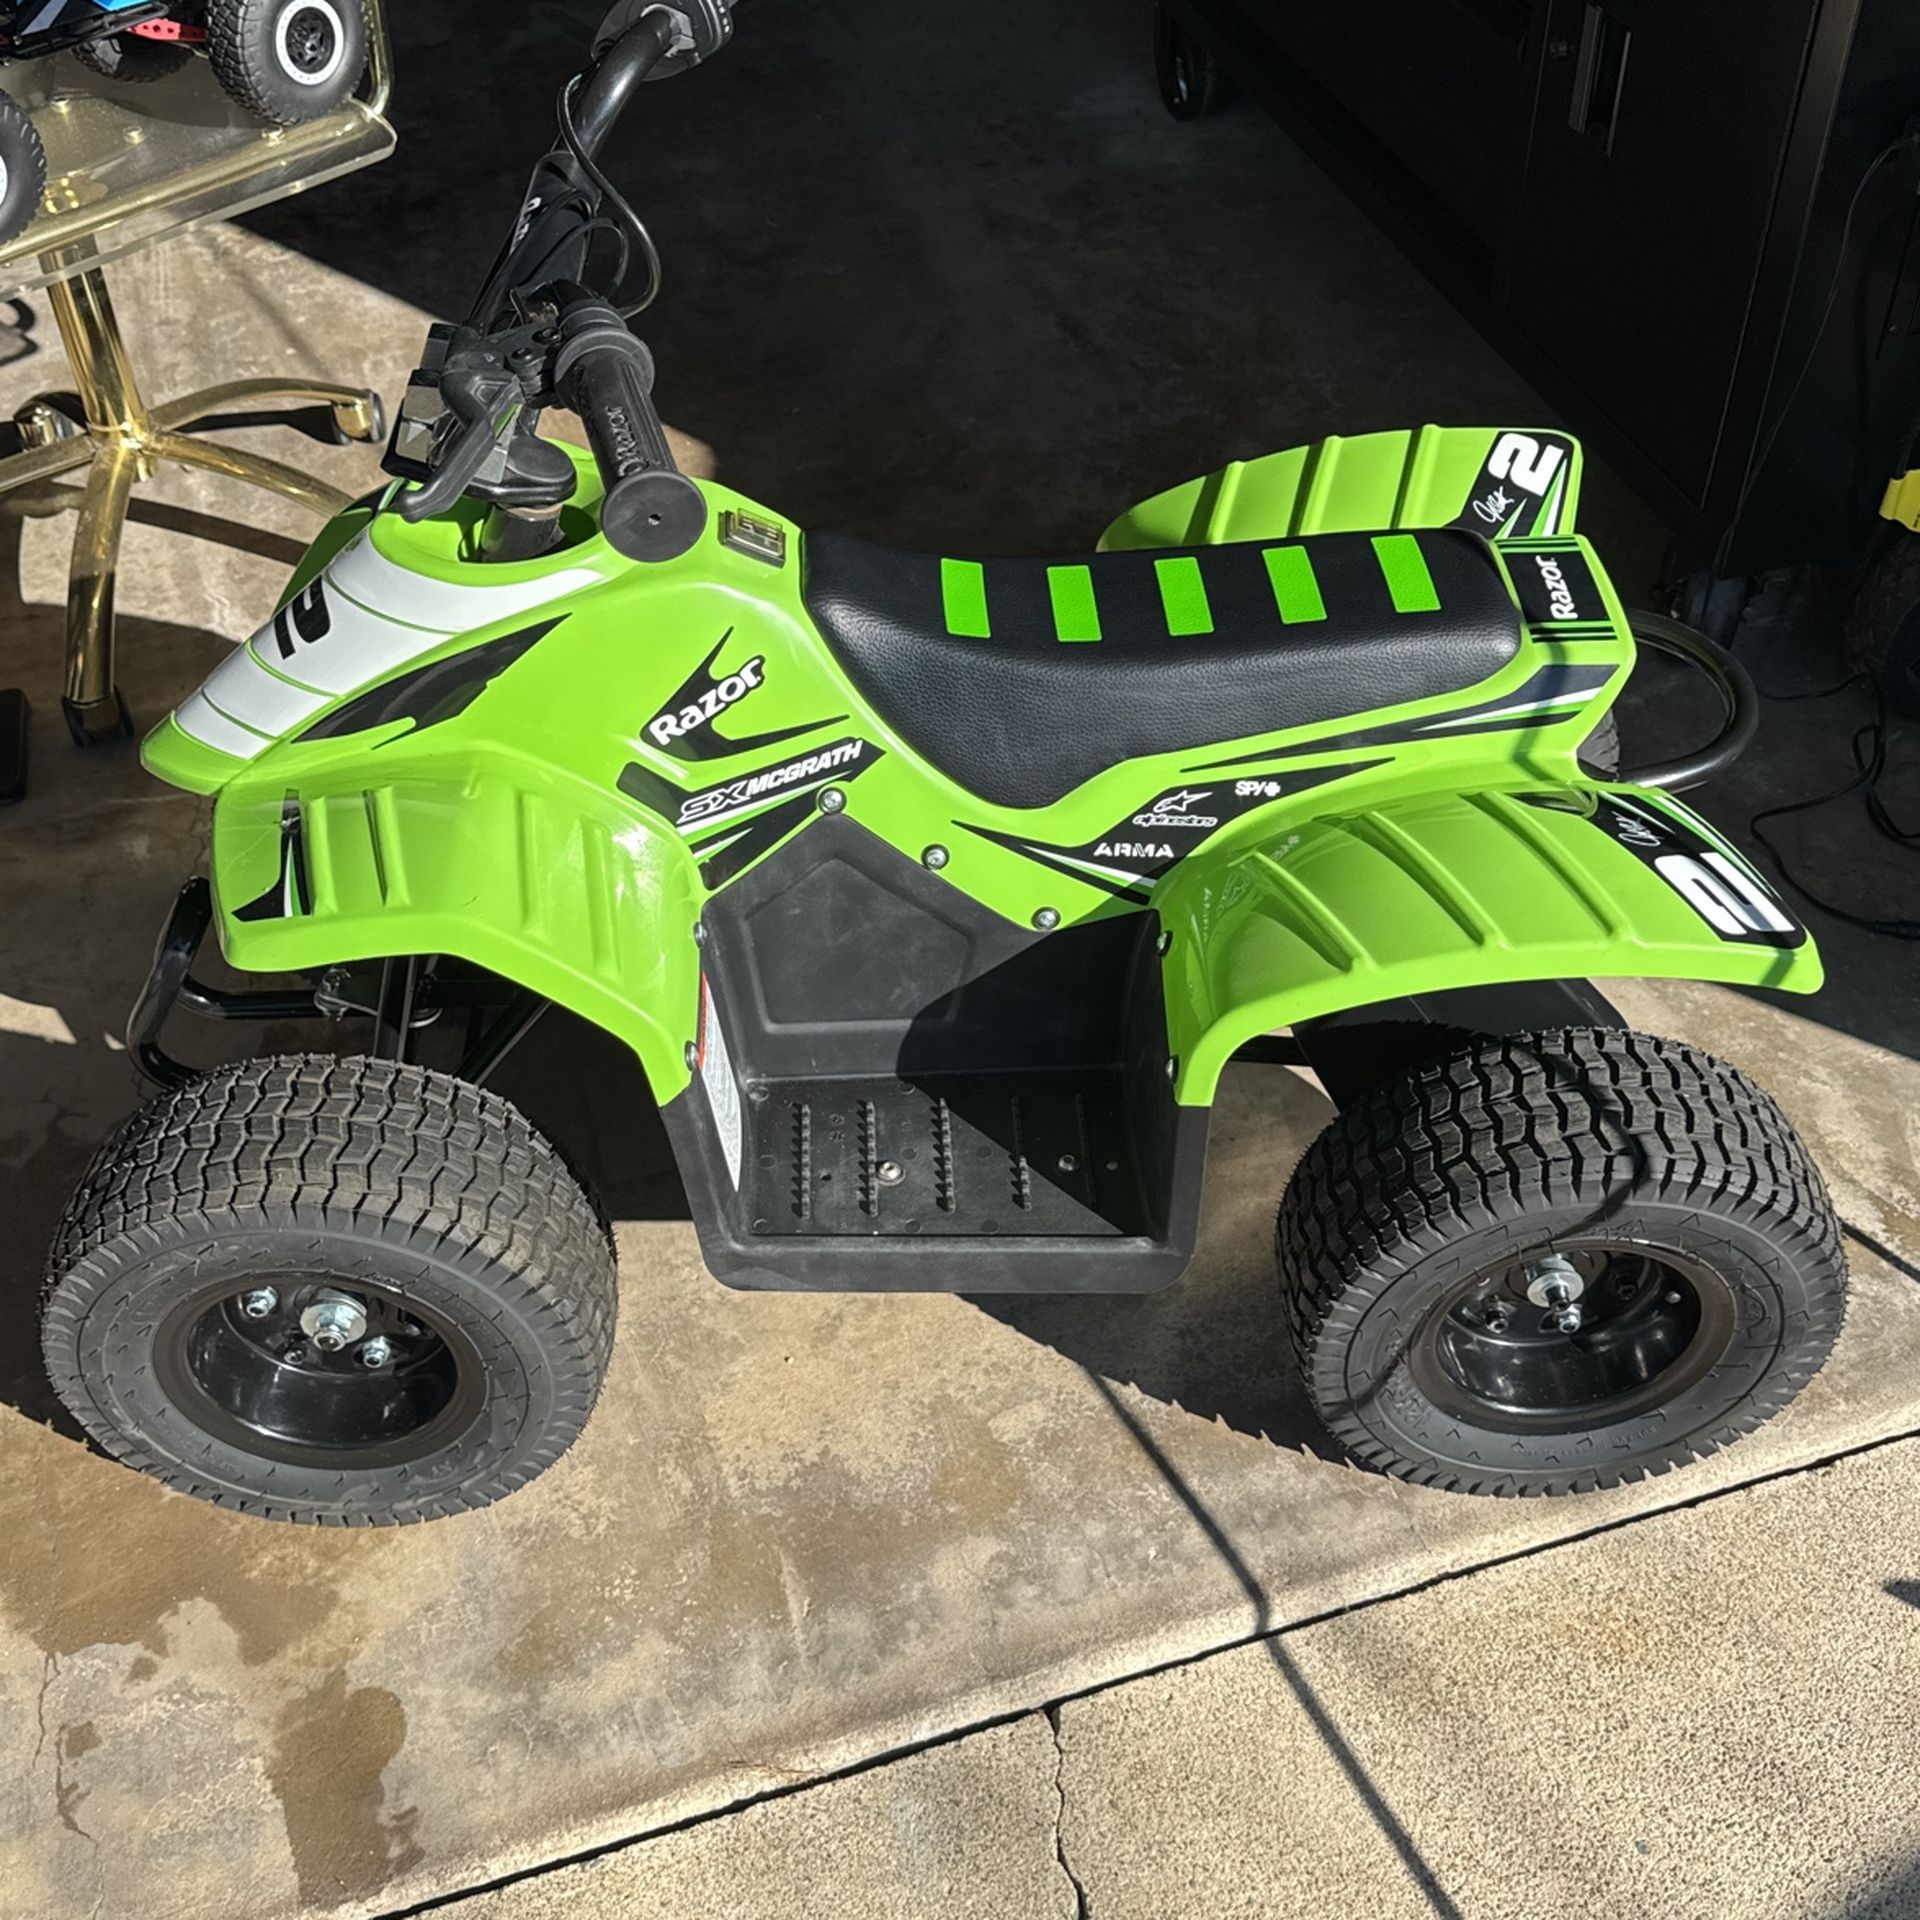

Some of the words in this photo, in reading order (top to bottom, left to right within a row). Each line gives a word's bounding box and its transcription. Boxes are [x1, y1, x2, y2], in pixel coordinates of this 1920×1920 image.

[1488, 433, 1564, 496] 2
[1535, 555, 1578, 619] Razor
[649, 659, 762, 745] Razor
[1093, 842, 1174, 858] ARMA
